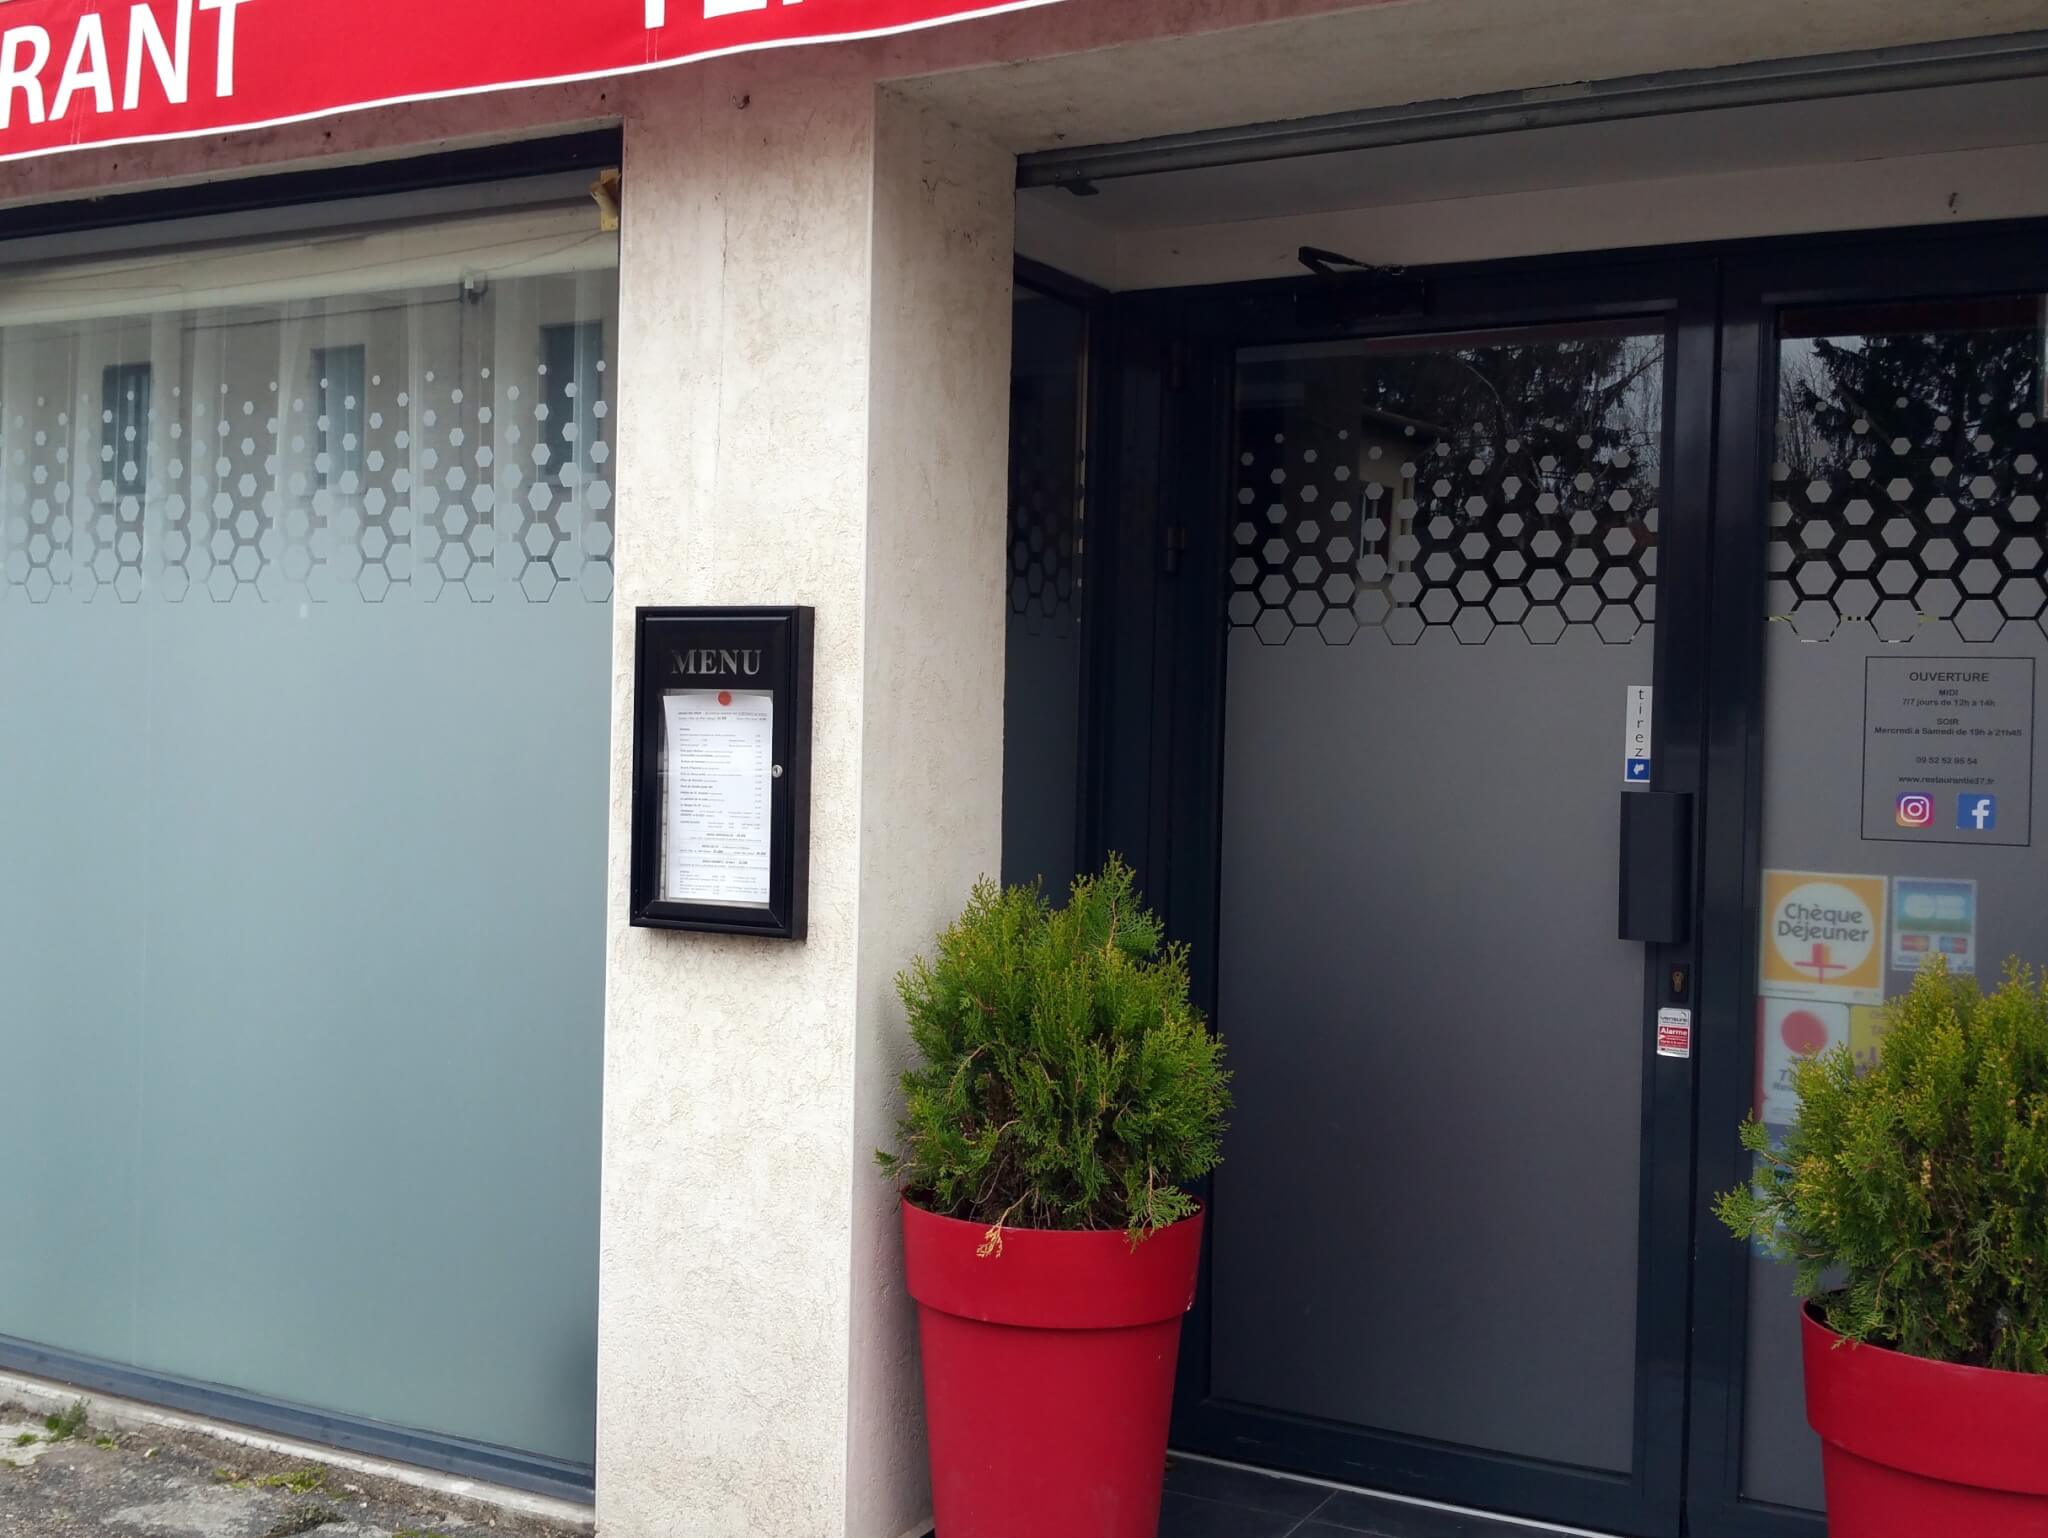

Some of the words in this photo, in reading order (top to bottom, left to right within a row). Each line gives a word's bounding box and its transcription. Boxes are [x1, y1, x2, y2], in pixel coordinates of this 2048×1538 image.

[671, 650, 762, 675] MENU
[1909, 672, 1990, 682] OUVERTURE
[1916, 699, 1939, 707] jours
[1635, 689, 1645, 757] tirez
[1922, 727, 1954, 735] Samedi
[1784, 902, 1863, 925] Chèque
[1778, 920, 1870, 942] Déjeuner
[1660, 1027, 1688, 1036] Alarme
